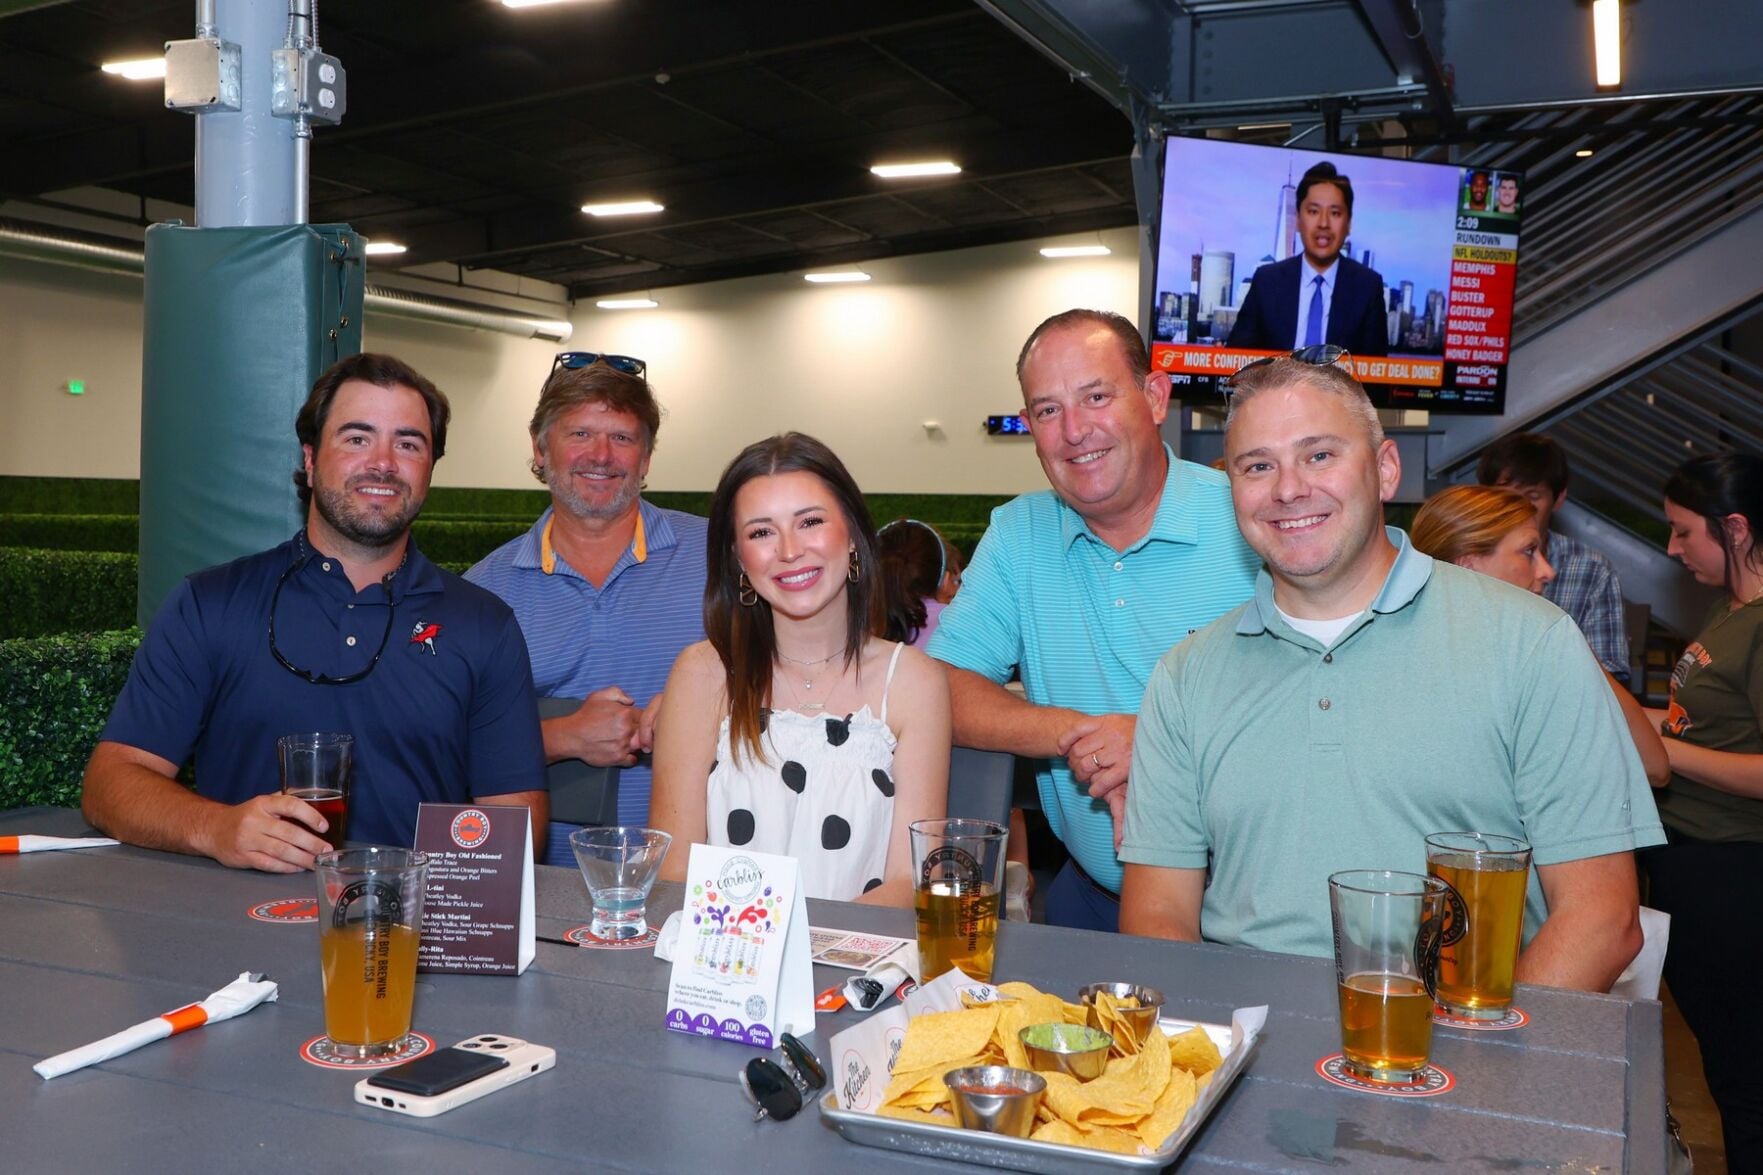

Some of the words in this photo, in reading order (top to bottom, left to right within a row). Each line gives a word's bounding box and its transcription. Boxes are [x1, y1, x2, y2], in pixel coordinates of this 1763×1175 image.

[1457, 217, 1479, 229] 2:09
[1457, 232, 1502, 245] RUNDOWN
[1455, 247, 1468, 258] NFL
[1470, 248, 1512, 261] HOLDOUTS?
[1453, 262, 1496, 275] MEMPHIS
[1452, 276, 1480, 288] MESSI
[1451, 291, 1485, 303] BUSTER
[1449, 305, 1494, 318] GOTTERUP
[1448, 320, 1487, 332] MADDUX
[1446, 334, 1463, 345] RED
[1445, 348, 1471, 360] HONEY
[1472, 350, 1503, 361] BADGER
[1184, 352, 1211, 367] MORE
[1357, 361, 1368, 376] TO
[1370, 362, 1387, 376] GET
[1388, 363, 1409, 378] DEAL
[1411, 364, 1441, 379] DONE?
[1457, 365, 1498, 376] PARDON
[446, 852, 457, 860] Boy
[458, 852, 470, 860] Old
[472, 852, 502, 860] Fashioned
[448, 913, 471, 921] Martini
[378, 941, 390, 957] BOY
[444, 961, 463, 969] Simple
[364, 965, 375, 983] USA
[376, 960, 389, 999] BREWING
[676, 1010, 684, 1021] 0
[702, 1015, 710, 1027] 0
[669, 1020, 688, 1030] carbs
[696, 1026, 715, 1036] sugar
[725, 1021, 740, 1033] 100
[720, 1031, 744, 1041] calories
[749, 1028, 770, 1038] gluten
[752, 1035, 766, 1045] free
[847, 1061, 859, 1079] The
[842, 1065, 871, 1110] Kitchen
